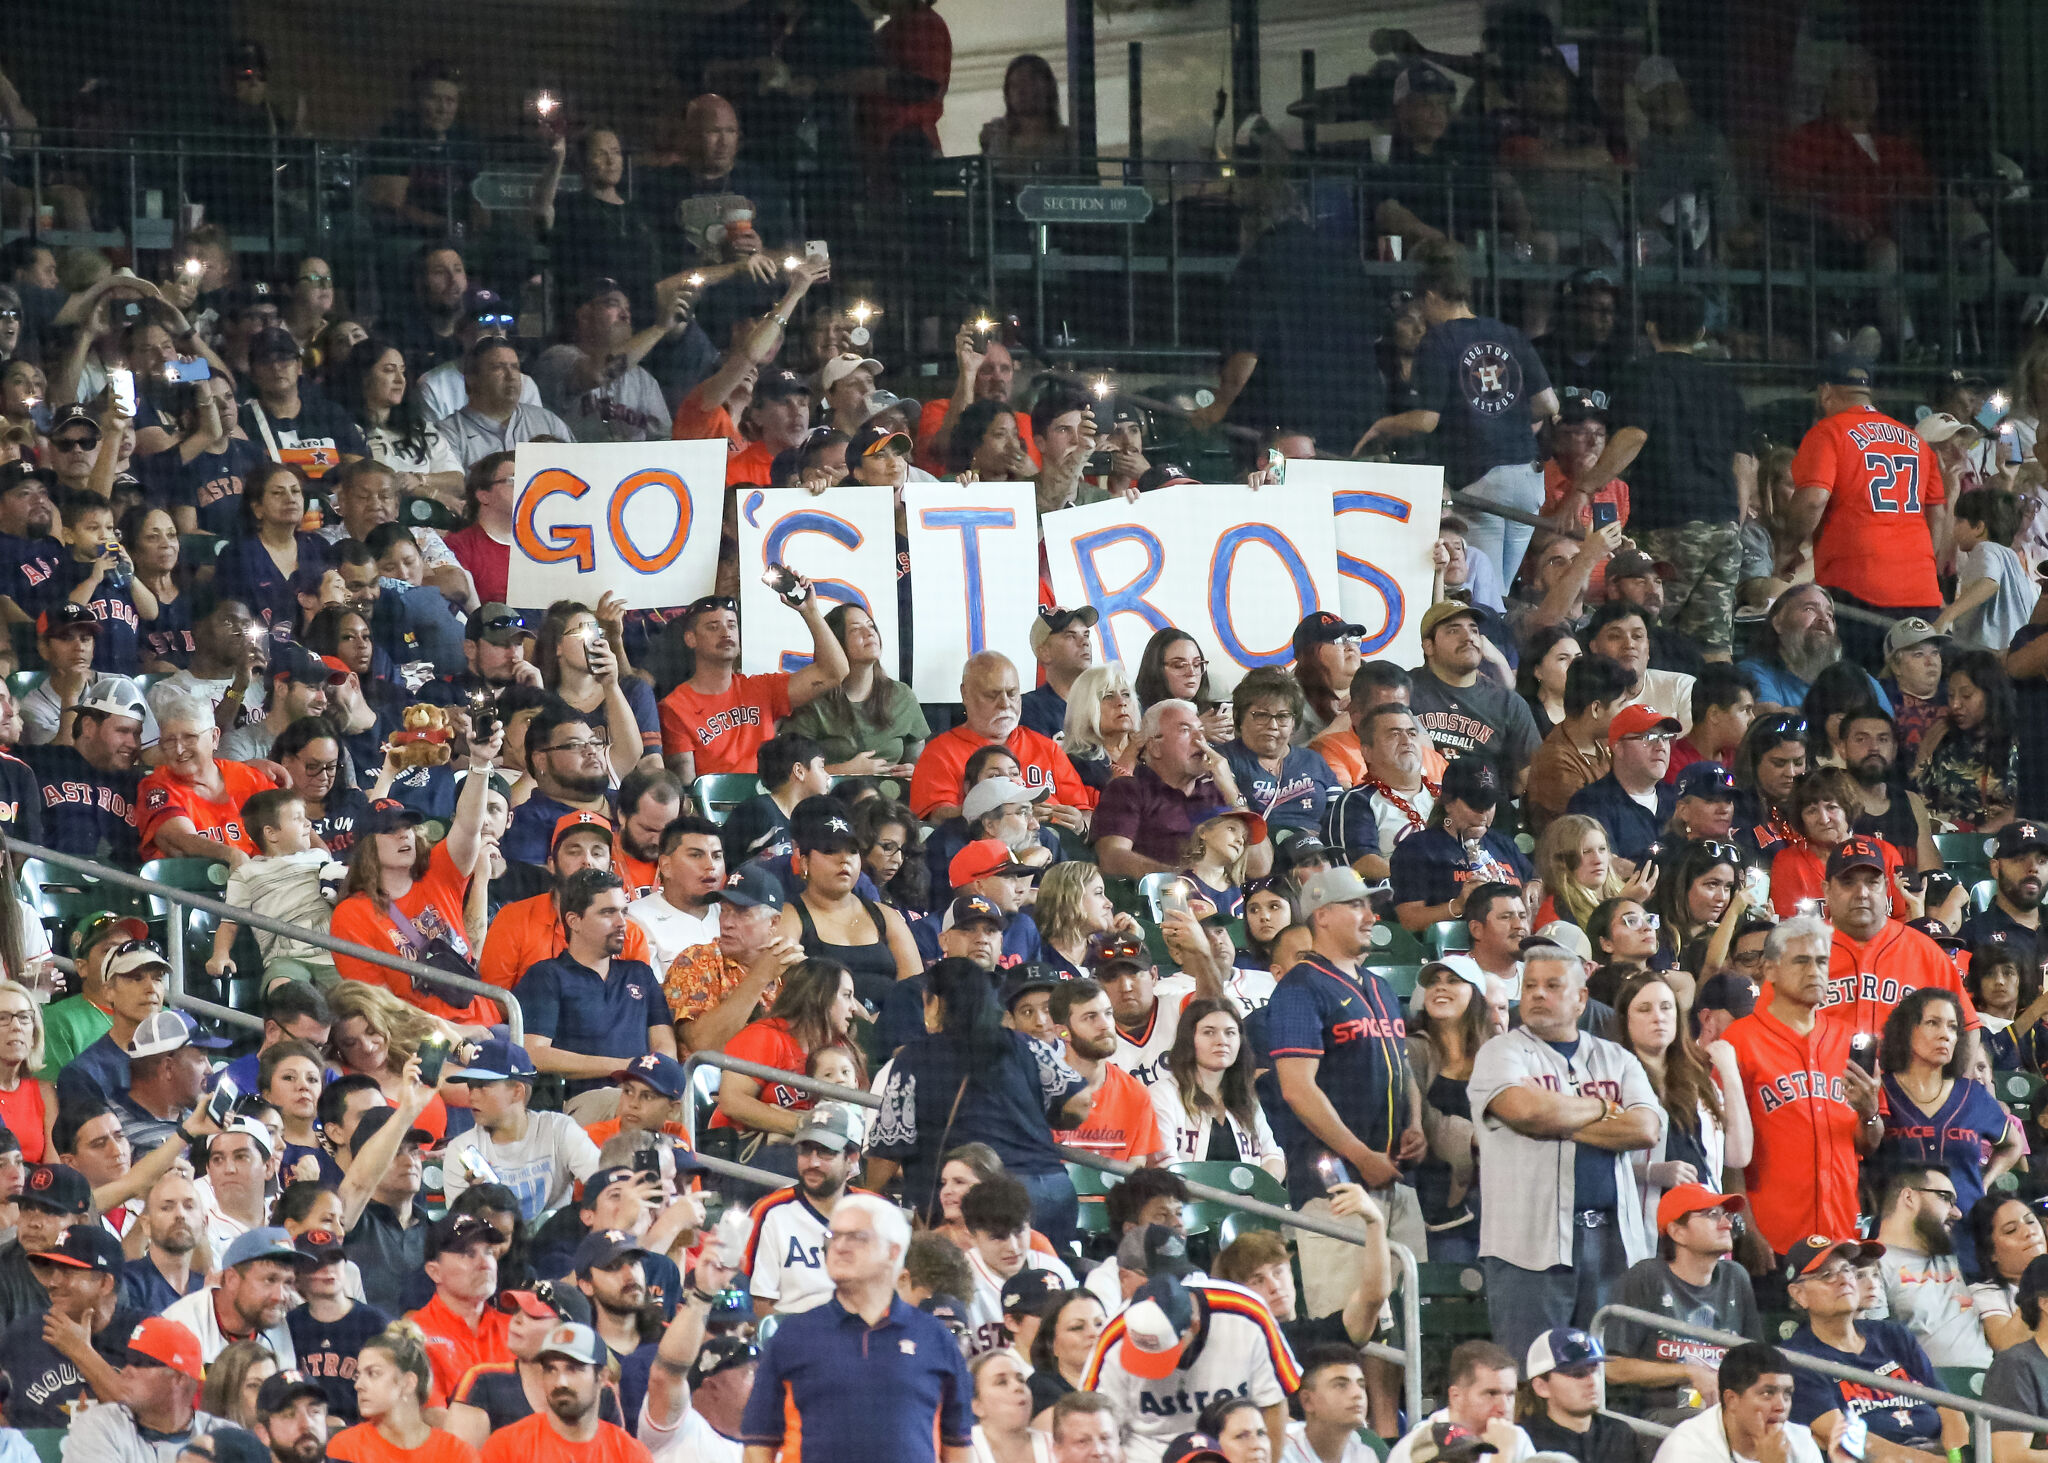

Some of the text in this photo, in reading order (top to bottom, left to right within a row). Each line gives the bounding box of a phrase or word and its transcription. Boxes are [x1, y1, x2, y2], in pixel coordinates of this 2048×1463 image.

[1042, 197, 1133, 211] SECTION 109
[1463, 344, 1510, 368] HOUTON
[1478, 364, 1502, 392] H
[1472, 390, 1516, 413] ASTROS
[1848, 421, 1920, 453] ALTUVE
[1865, 453, 1921, 514] 27
[512, 467, 694, 575] GO
[696, 706, 760, 746] ASTROS
[1429, 732, 1476, 750] BASEBALL
[42, 781, 136, 827] ASTROS
[579, 813, 592, 824] H
[1814, 976, 1917, 1011] STRO
[1332, 1017, 1392, 1044] SPACE
[1758, 1071, 1855, 1114] ASTRO
[1884, 1125, 1936, 1139] PACE
[1658, 1342, 1727, 1362] CHAMPIO
